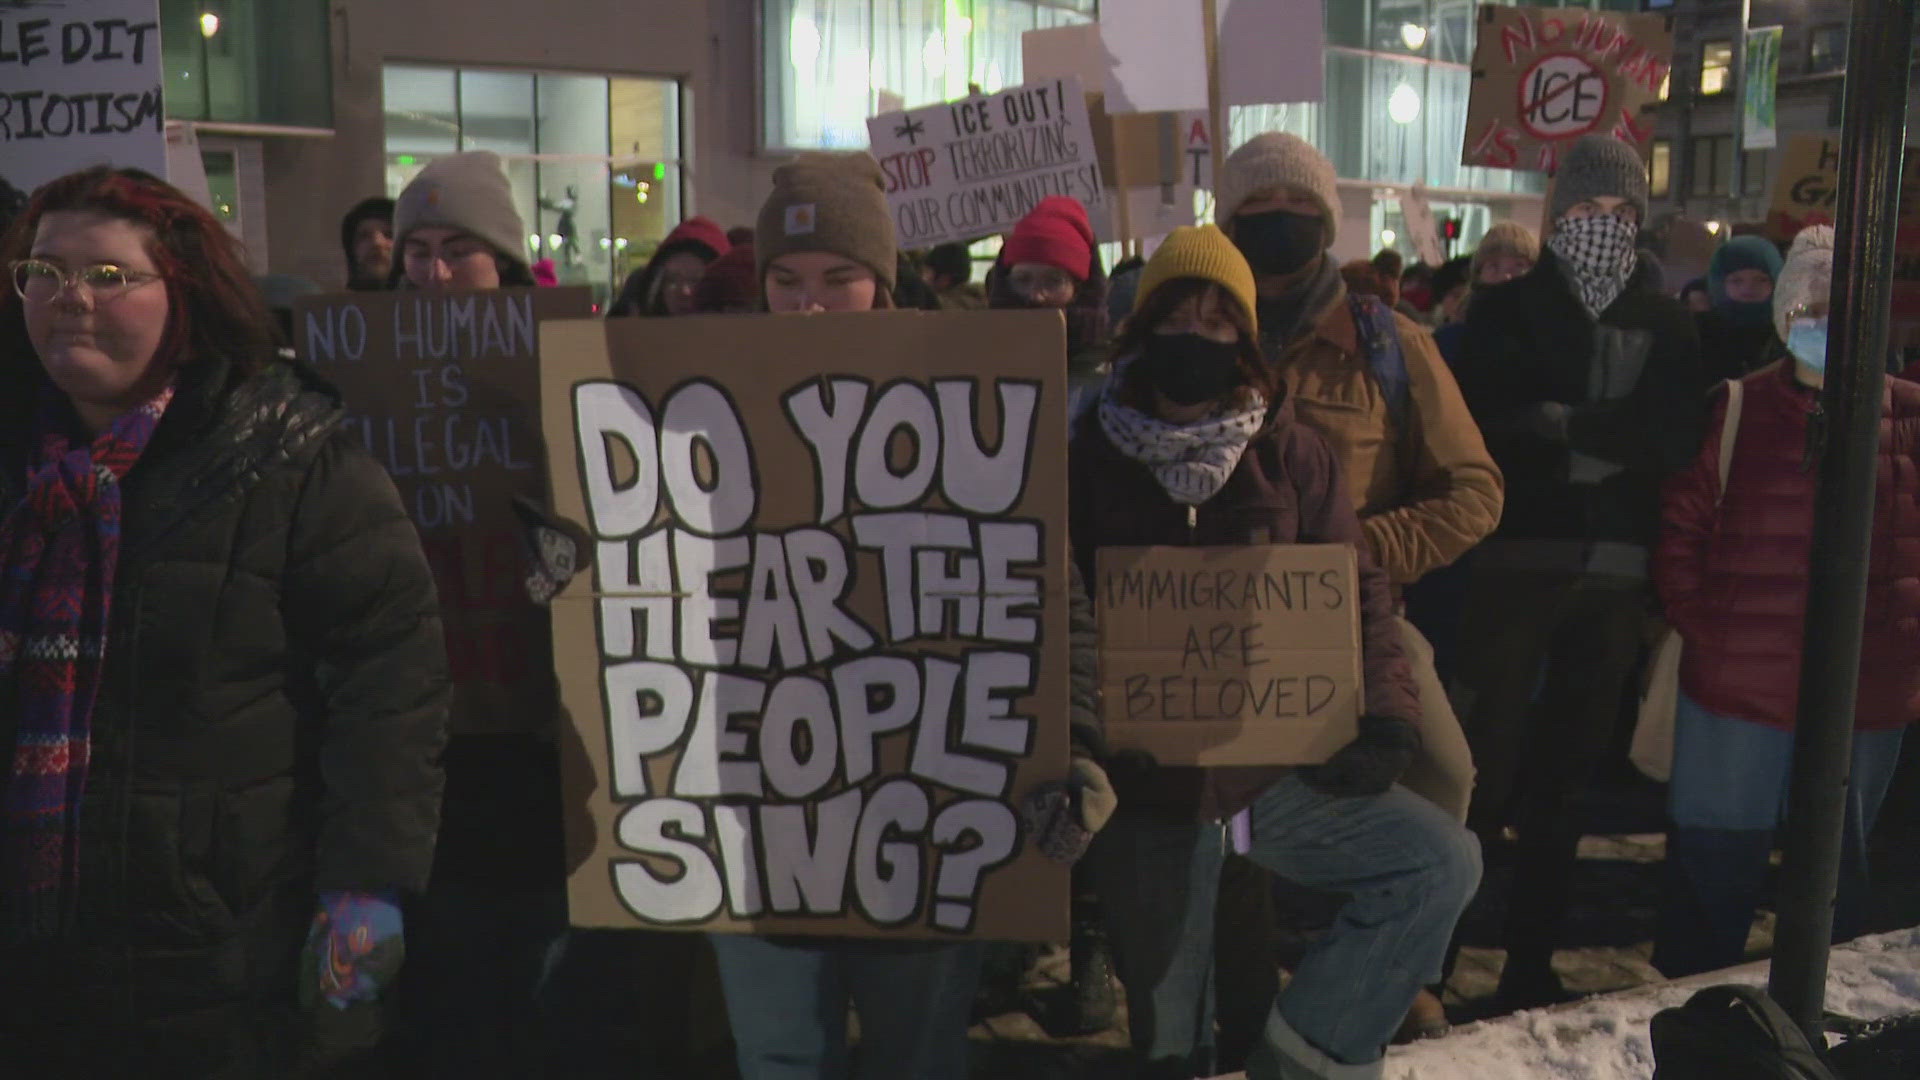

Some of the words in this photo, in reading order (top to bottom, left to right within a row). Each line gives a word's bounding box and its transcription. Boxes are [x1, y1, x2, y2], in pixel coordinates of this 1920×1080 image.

[1502, 13, 1565, 65] NO
[950, 100, 992, 138] ICE
[1003, 80, 1066, 127] OUT!
[1528, 67, 1603, 124] ICE
[880, 146, 936, 195] STOP
[943, 115, 1079, 181] TERRORIZING
[898, 196, 948, 239] OUR
[948, 163, 1100, 230] COMMUNITIES!
[306, 304, 368, 363] NO
[394, 294, 534, 360] HUMAN
[413, 363, 470, 409] IS
[571, 376, 761, 541] DO
[780, 374, 1043, 526] YOU
[416, 484, 475, 528] ON
[594, 526, 880, 673] HEAR
[849, 510, 1046, 646] THE
[1105, 568, 1344, 611] IMMIGRANTS
[1182, 622, 1271, 670] ARE
[601, 646, 1039, 804] PEOPLE
[1123, 672, 1337, 721] BELOVED
[608, 775, 1024, 934] SING?
